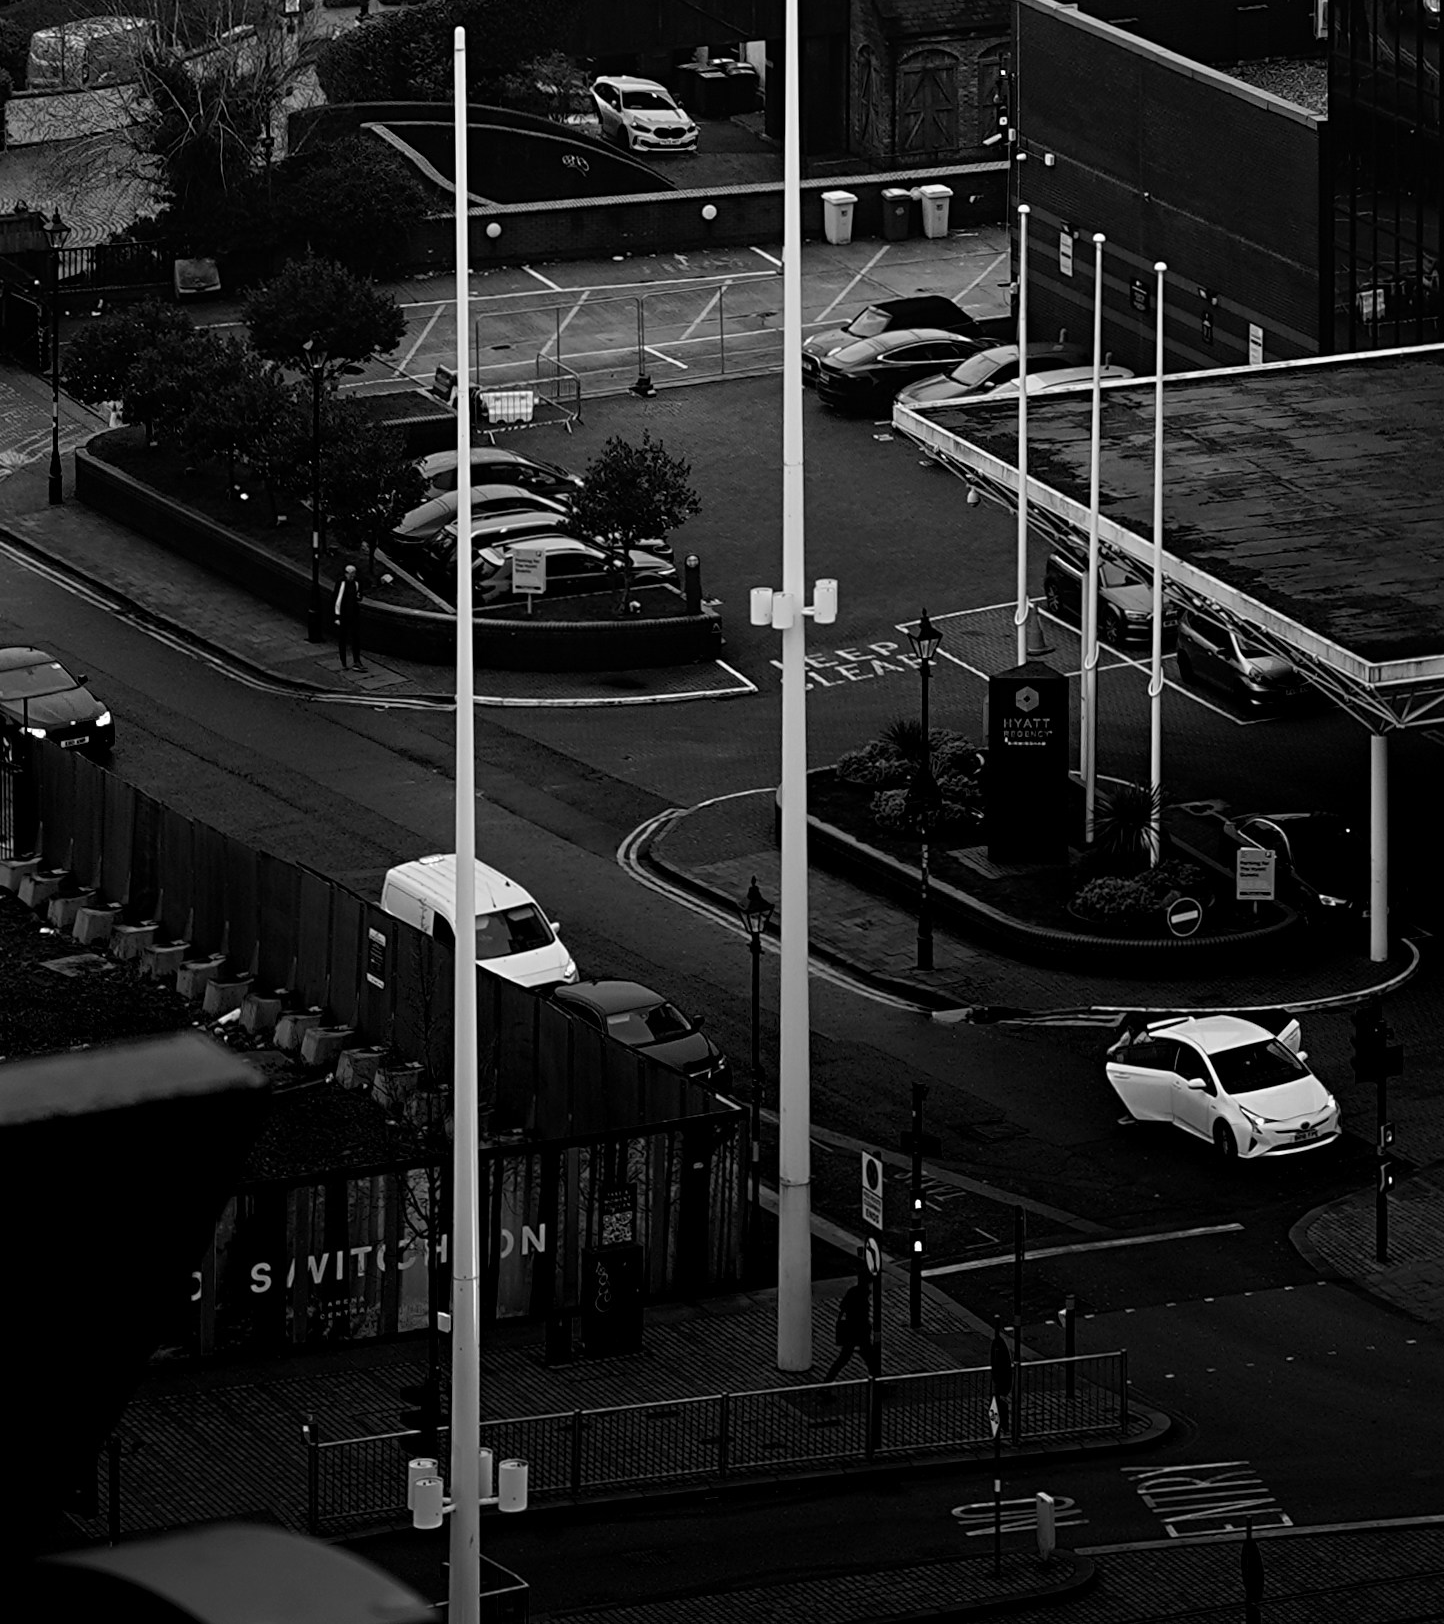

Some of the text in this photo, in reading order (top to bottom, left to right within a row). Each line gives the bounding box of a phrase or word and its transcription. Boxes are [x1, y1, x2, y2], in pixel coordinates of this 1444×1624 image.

[1003, 718, 1051, 729] HYATT
[1003, 729, 1050, 738] REGENCY
[250, 1233, 448, 1295] SWITCH
[320, 1305, 371, 1320] CENTRA
